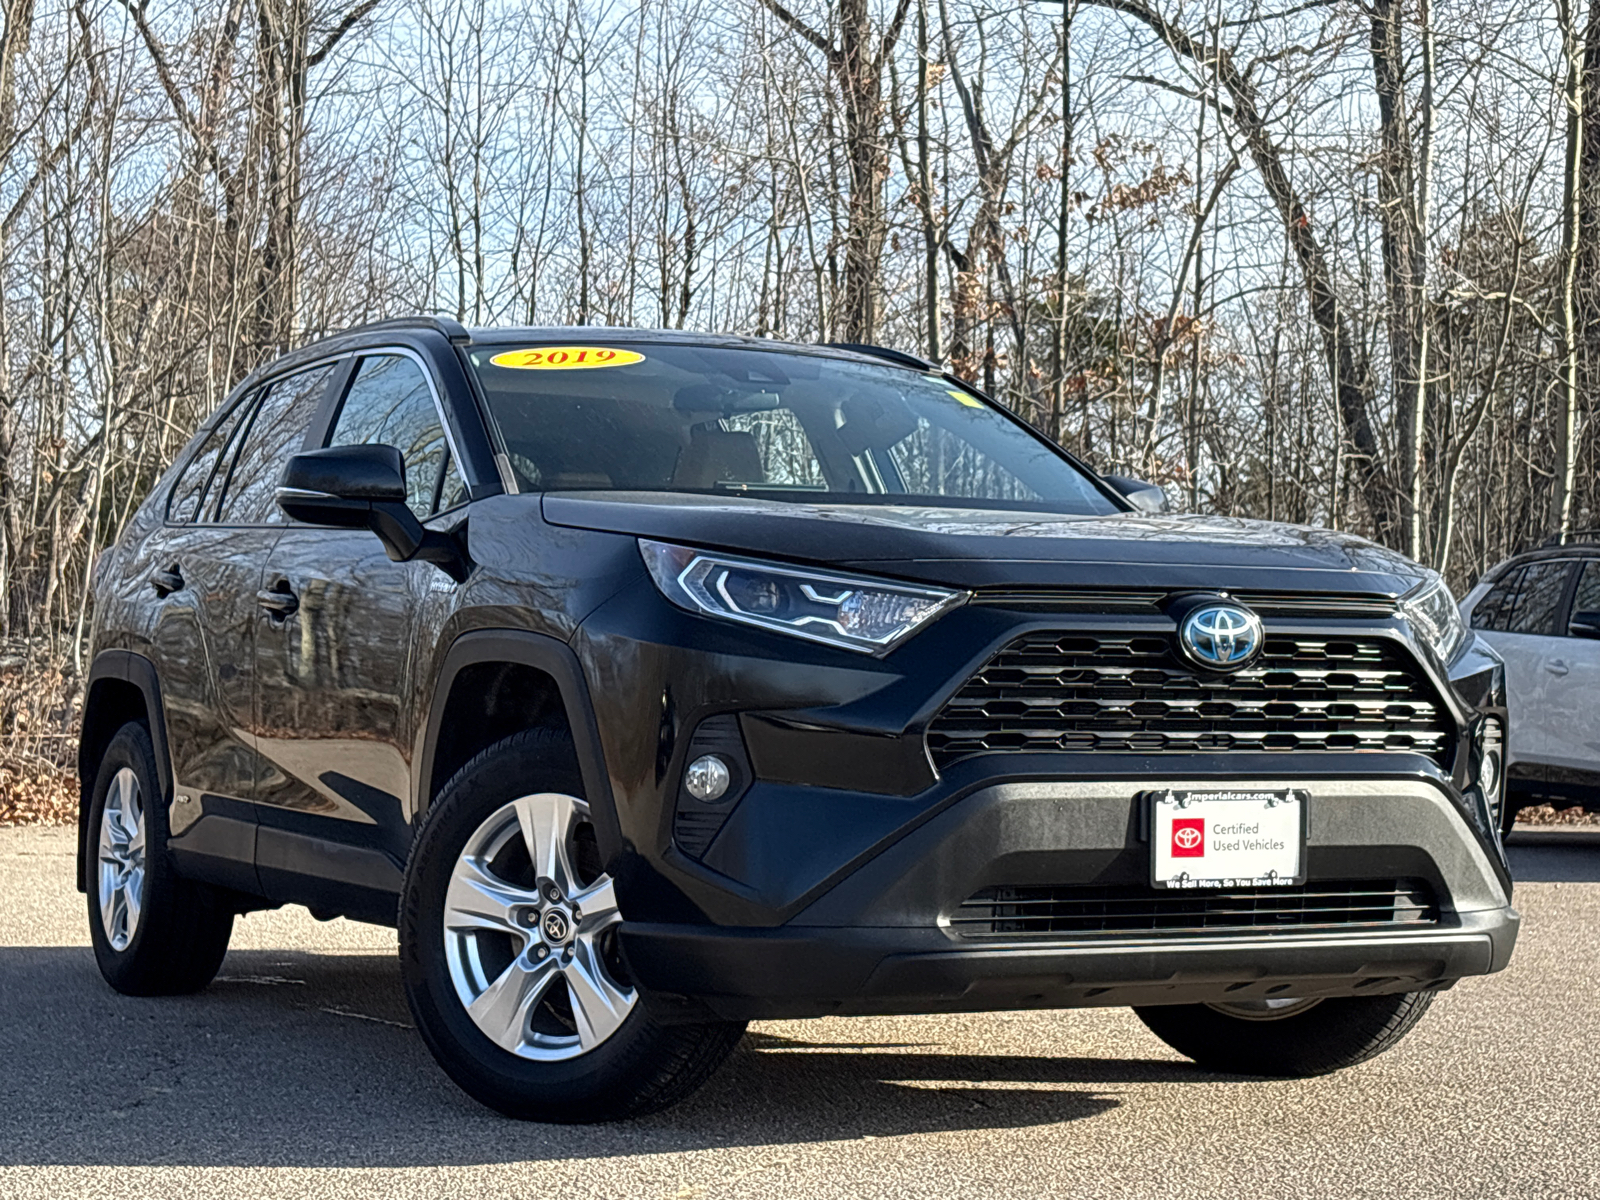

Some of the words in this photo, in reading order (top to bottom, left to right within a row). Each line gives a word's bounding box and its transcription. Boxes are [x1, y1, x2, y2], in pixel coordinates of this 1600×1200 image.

[522, 350, 617, 366] 2019
[1213, 822, 1259, 835] Certified
[1213, 839, 1240, 851] Used
[1242, 838, 1285, 850] Vehicles
[1166, 880, 1180, 889] We
[1181, 880, 1197, 888] Sell
[1199, 880, 1222, 889] More,
[1223, 879, 1234, 887] So
[1235, 879, 1251, 887] You
[1252, 878, 1272, 886] Save
[1272, 878, 1293, 886] More
